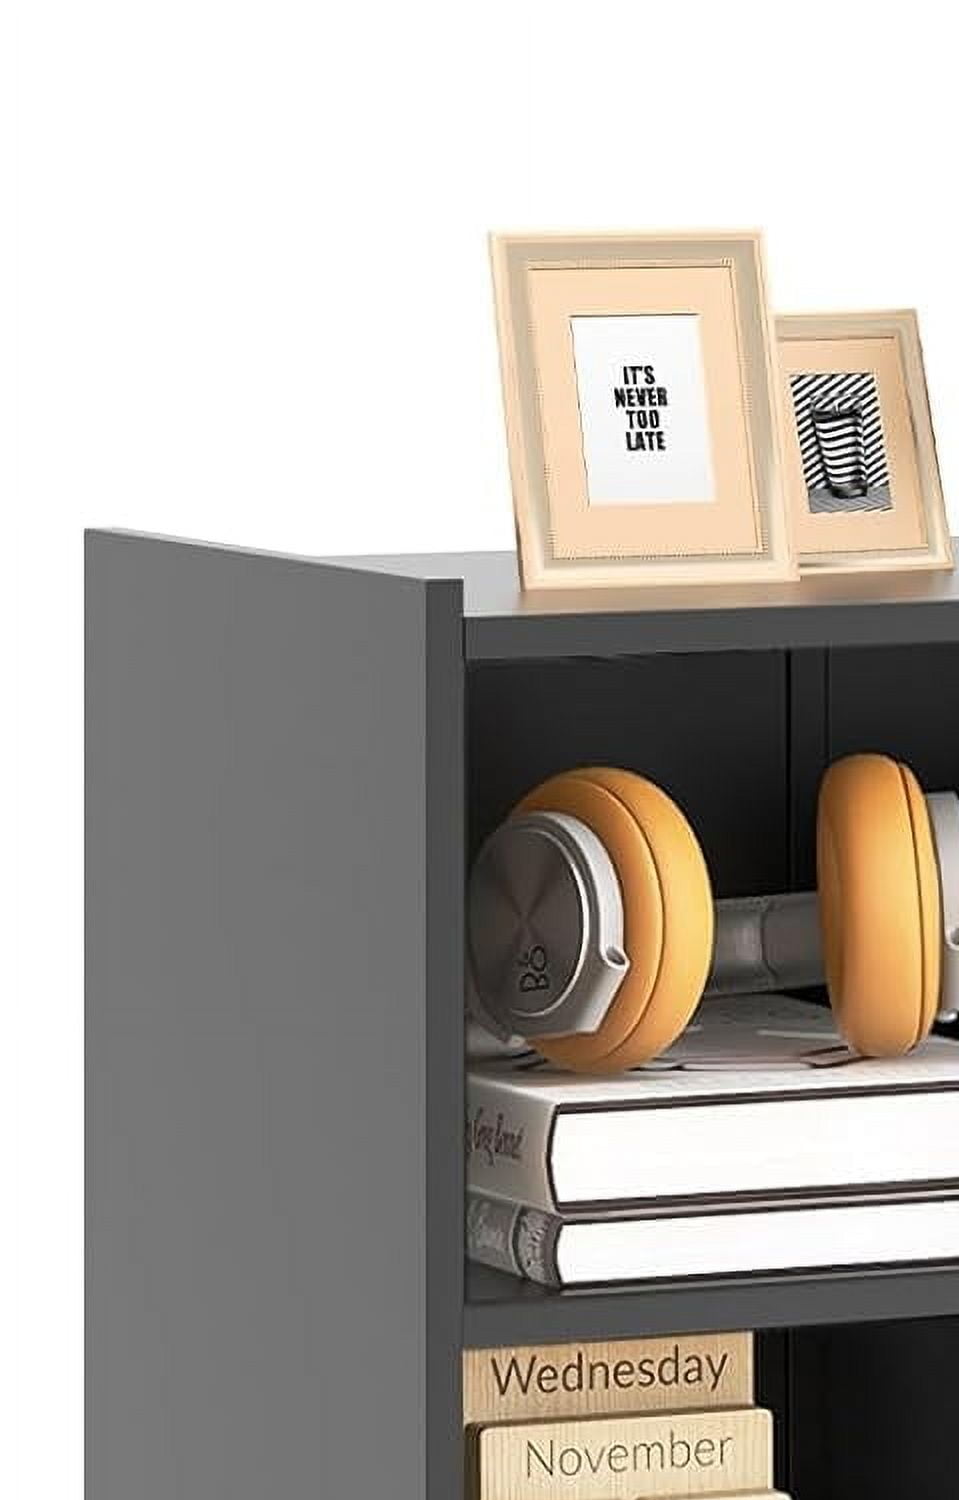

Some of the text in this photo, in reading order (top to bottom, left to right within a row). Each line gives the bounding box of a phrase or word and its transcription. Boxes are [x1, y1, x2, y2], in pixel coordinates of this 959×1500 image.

[622, 365, 656, 385] IT'S
[614, 386, 668, 408] NEVER
[625, 409, 660, 430] TOO
[625, 430, 666, 451] LATE
[490, 1343, 729, 1396] Wednesday
[525, 1431, 735, 1479] November
